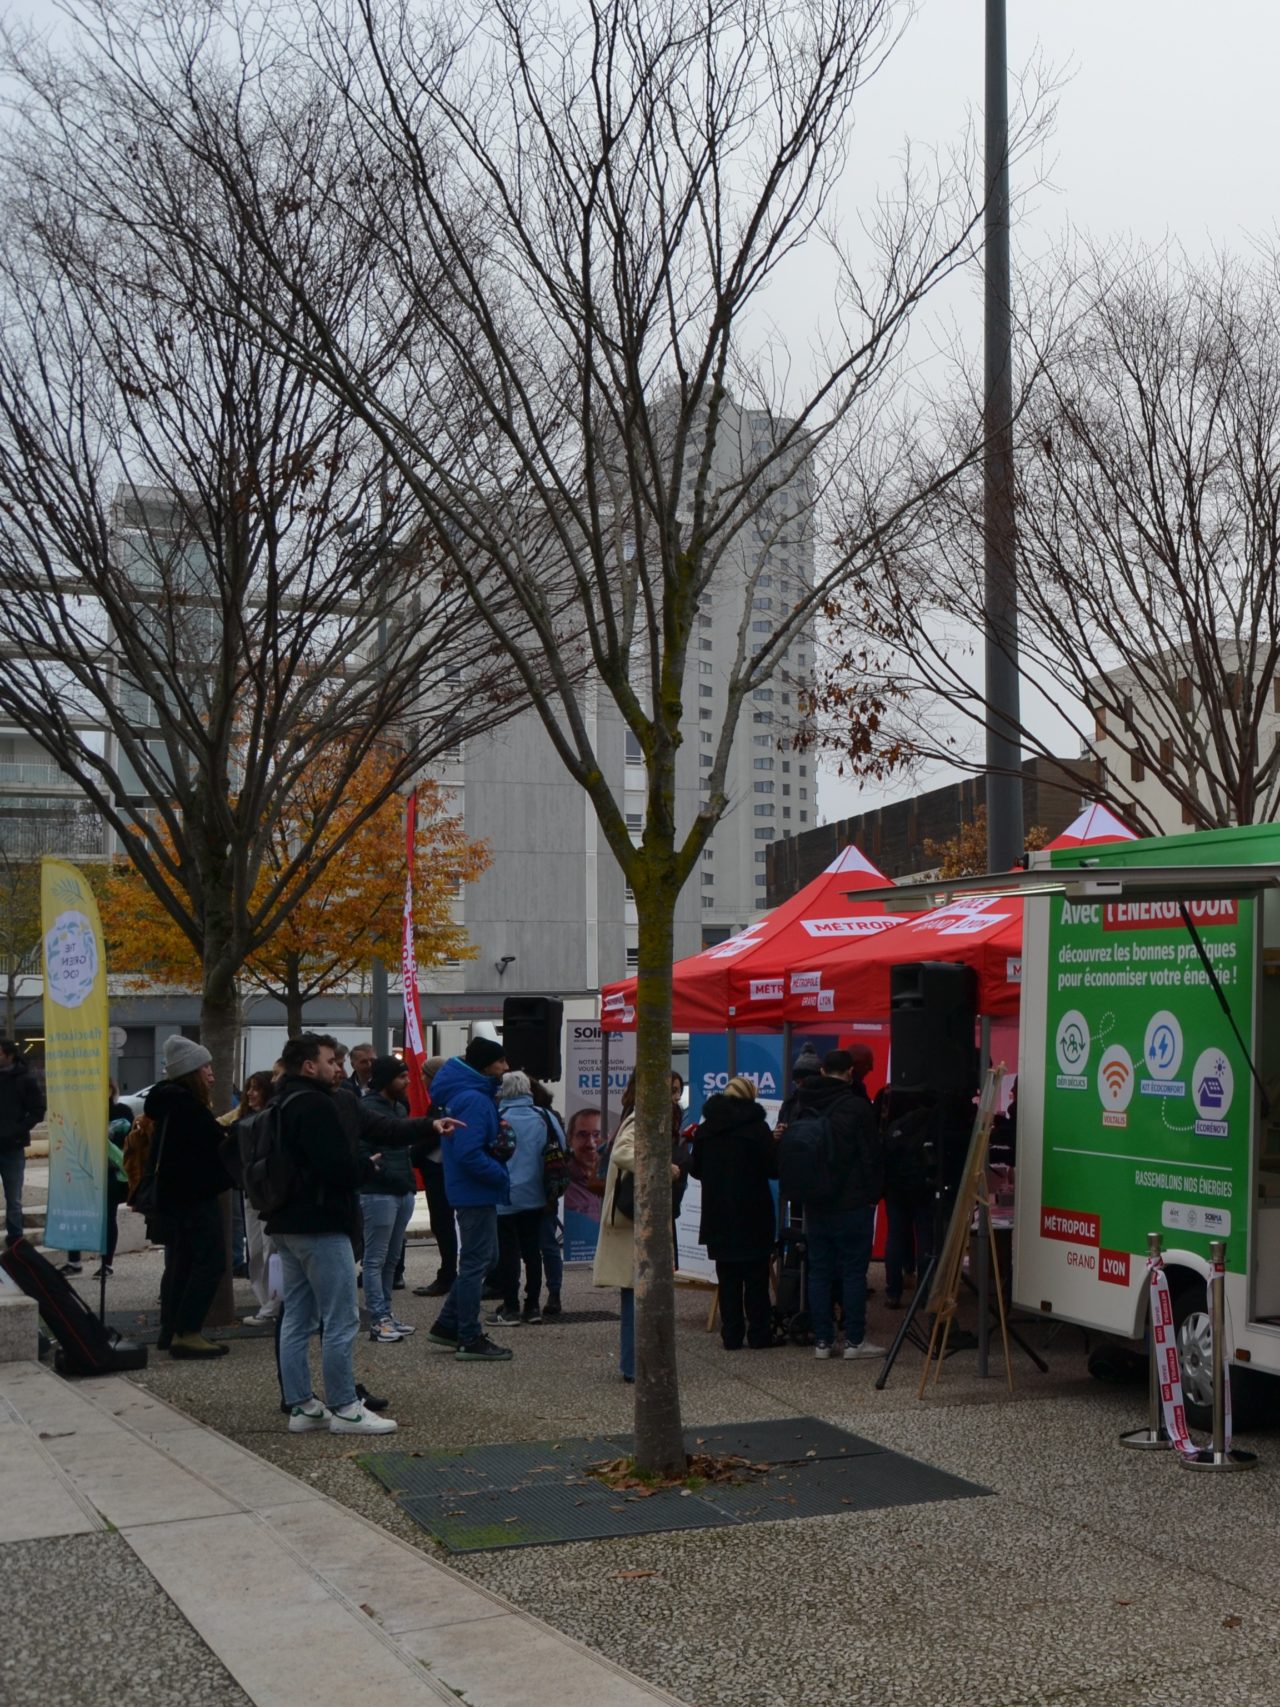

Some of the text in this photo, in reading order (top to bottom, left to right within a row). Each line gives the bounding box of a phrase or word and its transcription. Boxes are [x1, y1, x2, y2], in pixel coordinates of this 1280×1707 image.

[1060, 900, 1100, 925] Avec
[1059, 937, 1236, 964] découvrez les bonnes praiques
[1057, 971, 1083, 991] pour
[1085, 965, 1148, 986] économiser
[1149, 968, 1181, 985] votre
[1104, 1113, 1126, 1125] VOLTALIS
[1135, 1170, 1233, 1198] RASSEMBLONS NOS ÉNERGIES
[1044, 1214, 1096, 1238] MÉTROPOLE
[1066, 1251, 1126, 1276] GRAND LYON
